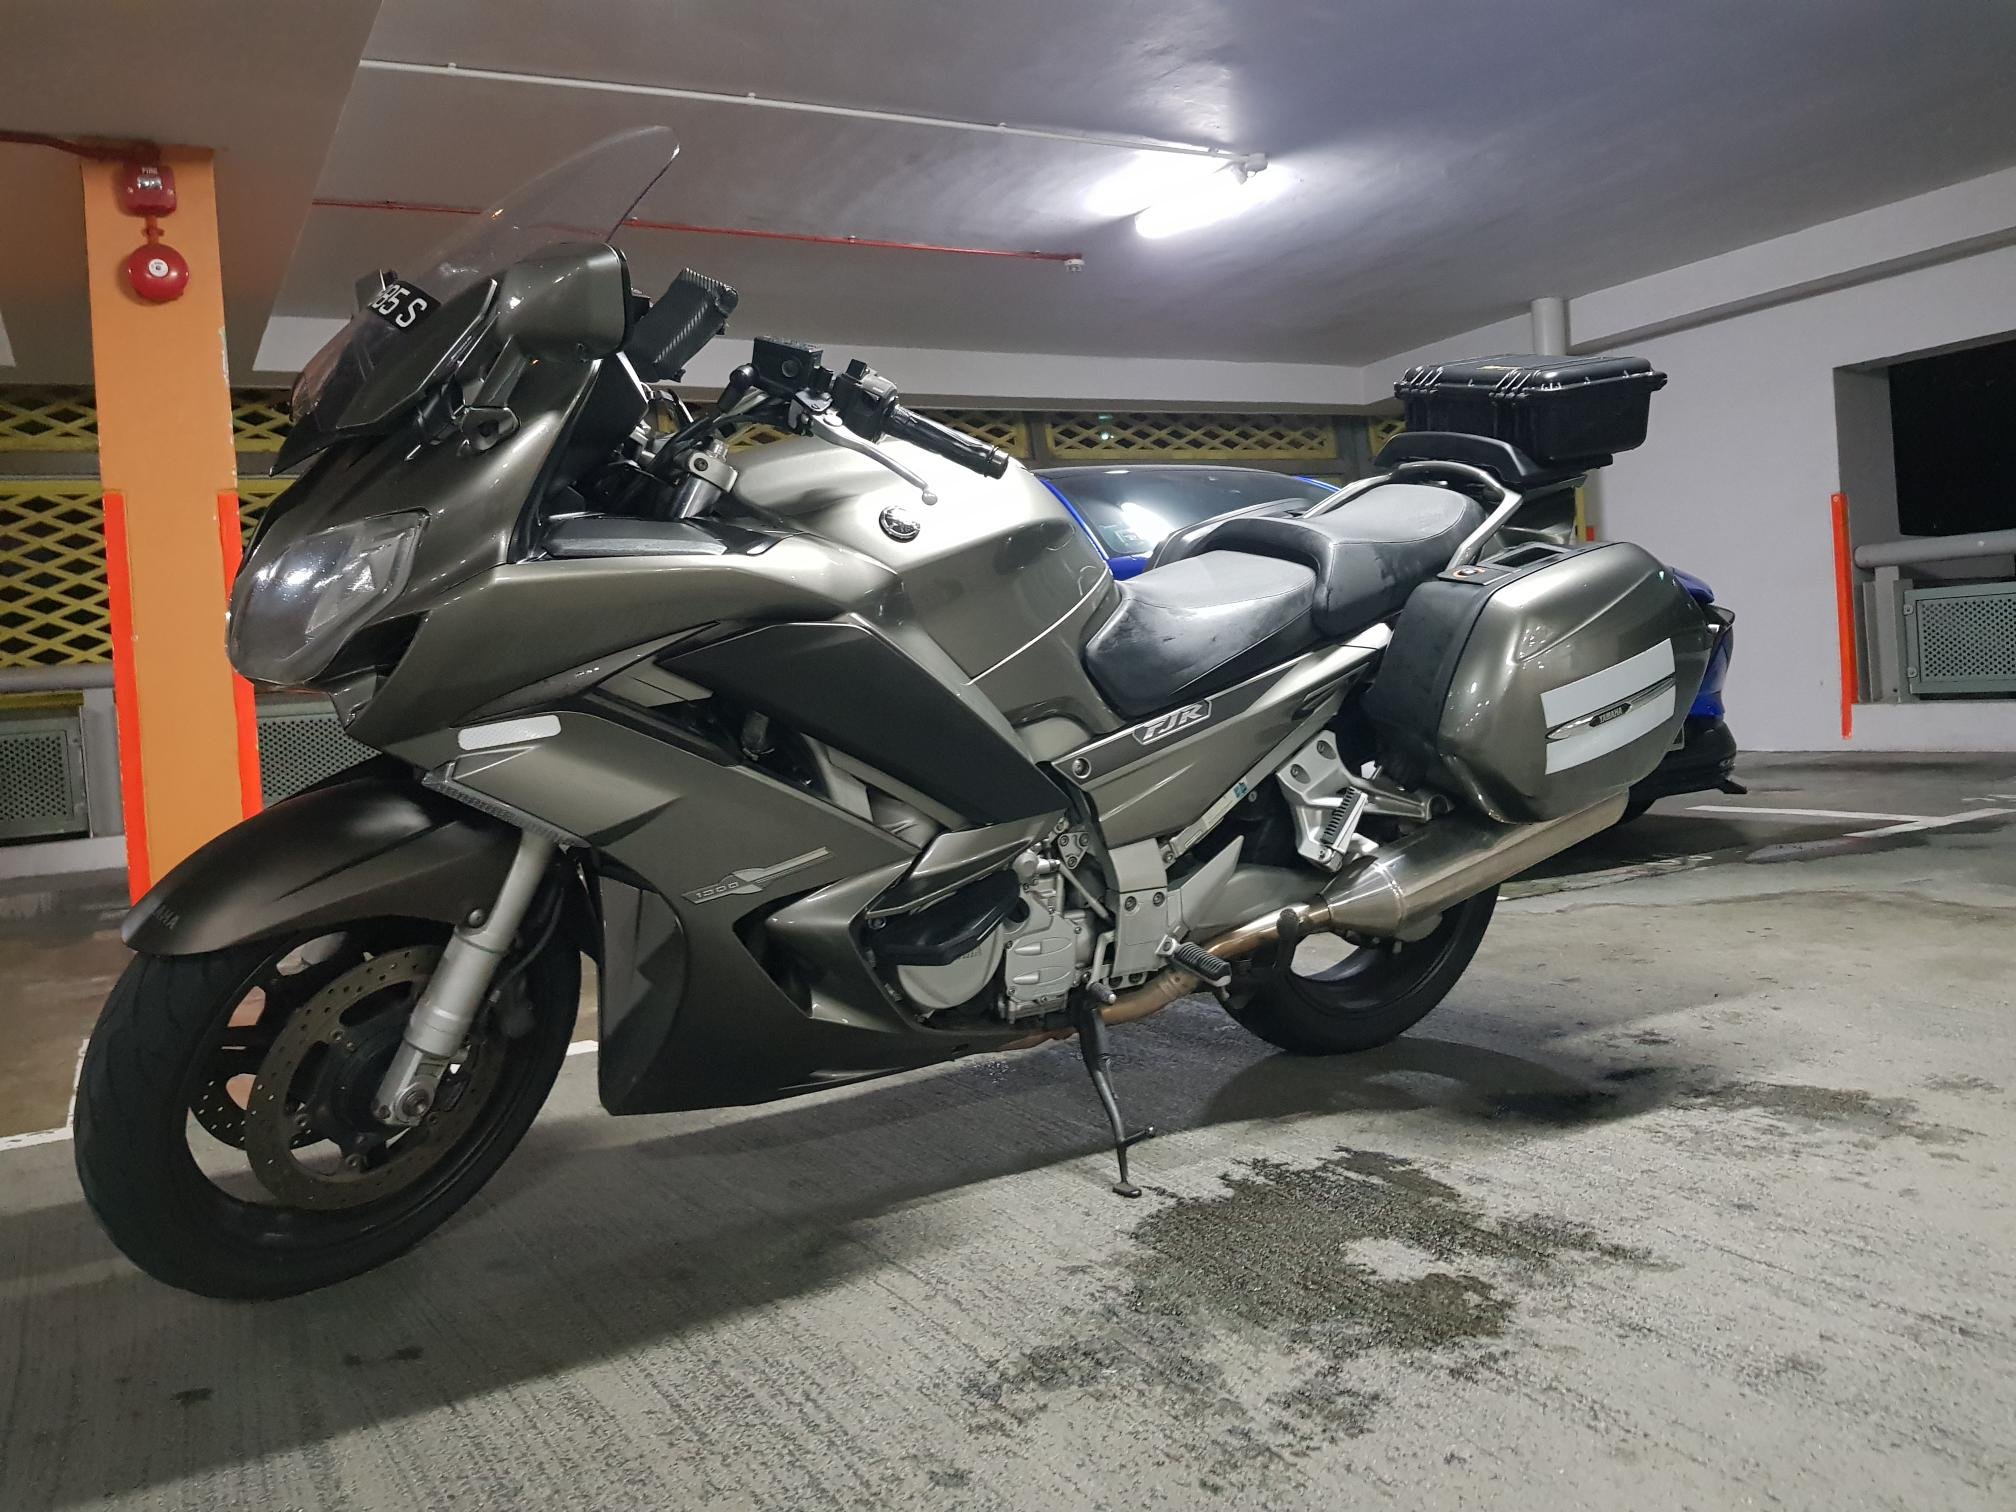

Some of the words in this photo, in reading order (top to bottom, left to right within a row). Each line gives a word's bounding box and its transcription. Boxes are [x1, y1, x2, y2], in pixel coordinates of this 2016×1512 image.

[368, 284, 411, 315] 85
[395, 298, 428, 328] S
[1142, 703, 1203, 741] FJR
[1599, 707, 1623, 723] YAMAHA
